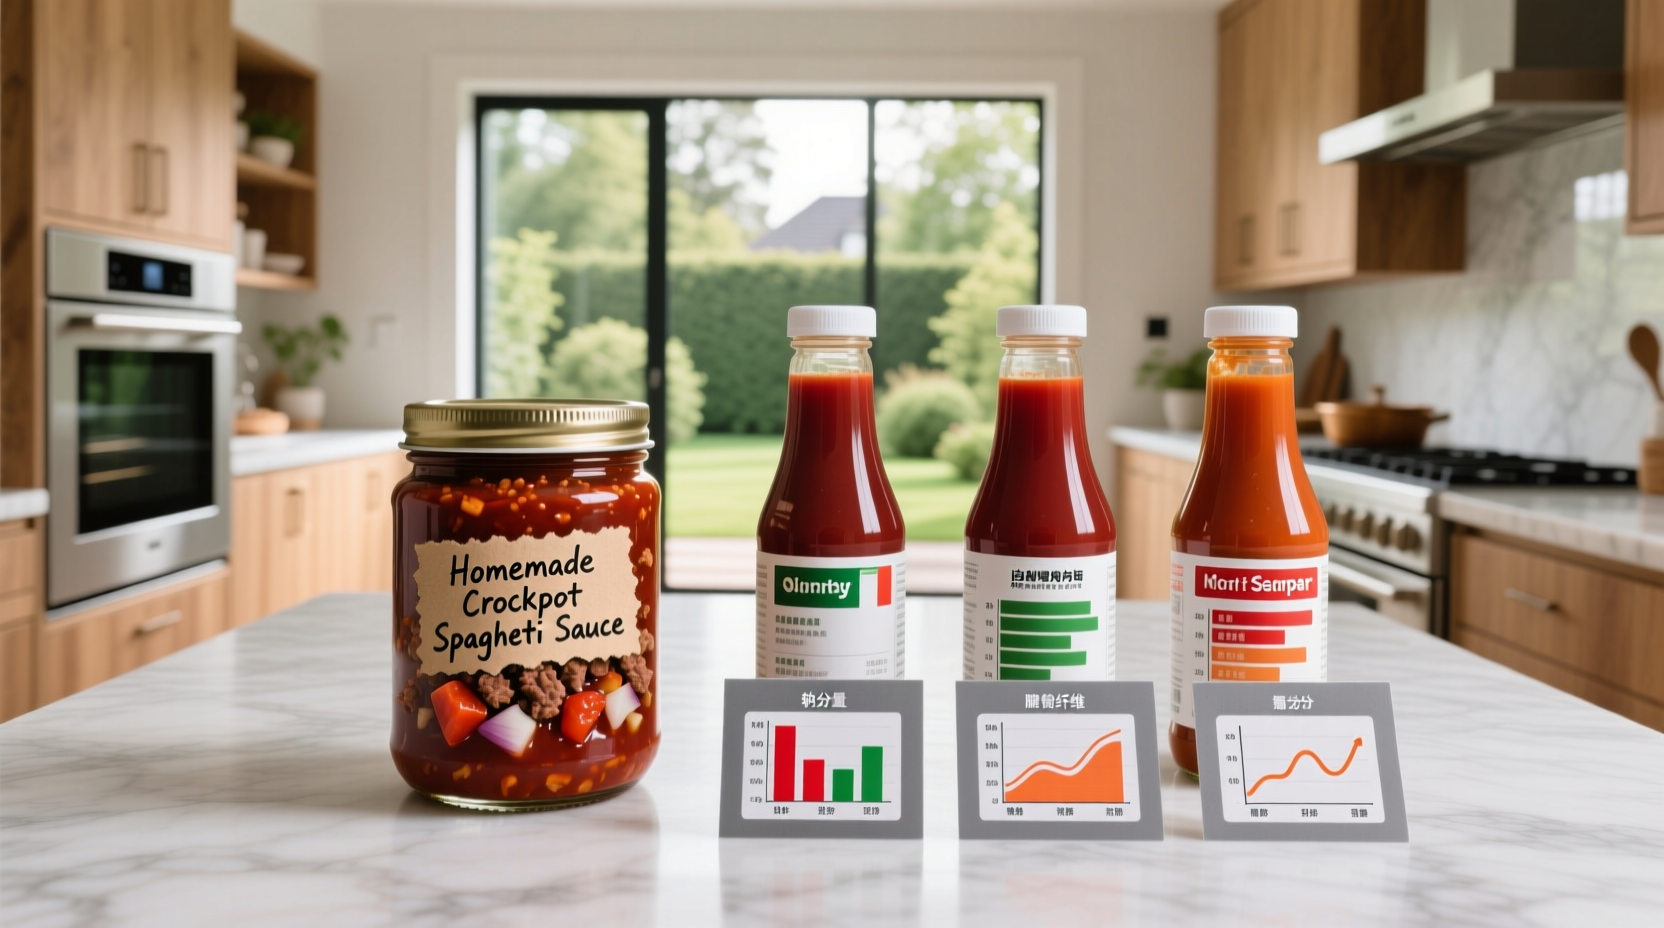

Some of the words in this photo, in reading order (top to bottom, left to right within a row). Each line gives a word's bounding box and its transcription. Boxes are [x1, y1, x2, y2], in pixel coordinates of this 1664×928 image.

[450, 544, 595, 586] Homemade
[462, 582, 583, 618] Crockpot
[433, 619, 543, 663] Spagheti
[555, 614, 625, 642] Sauce
